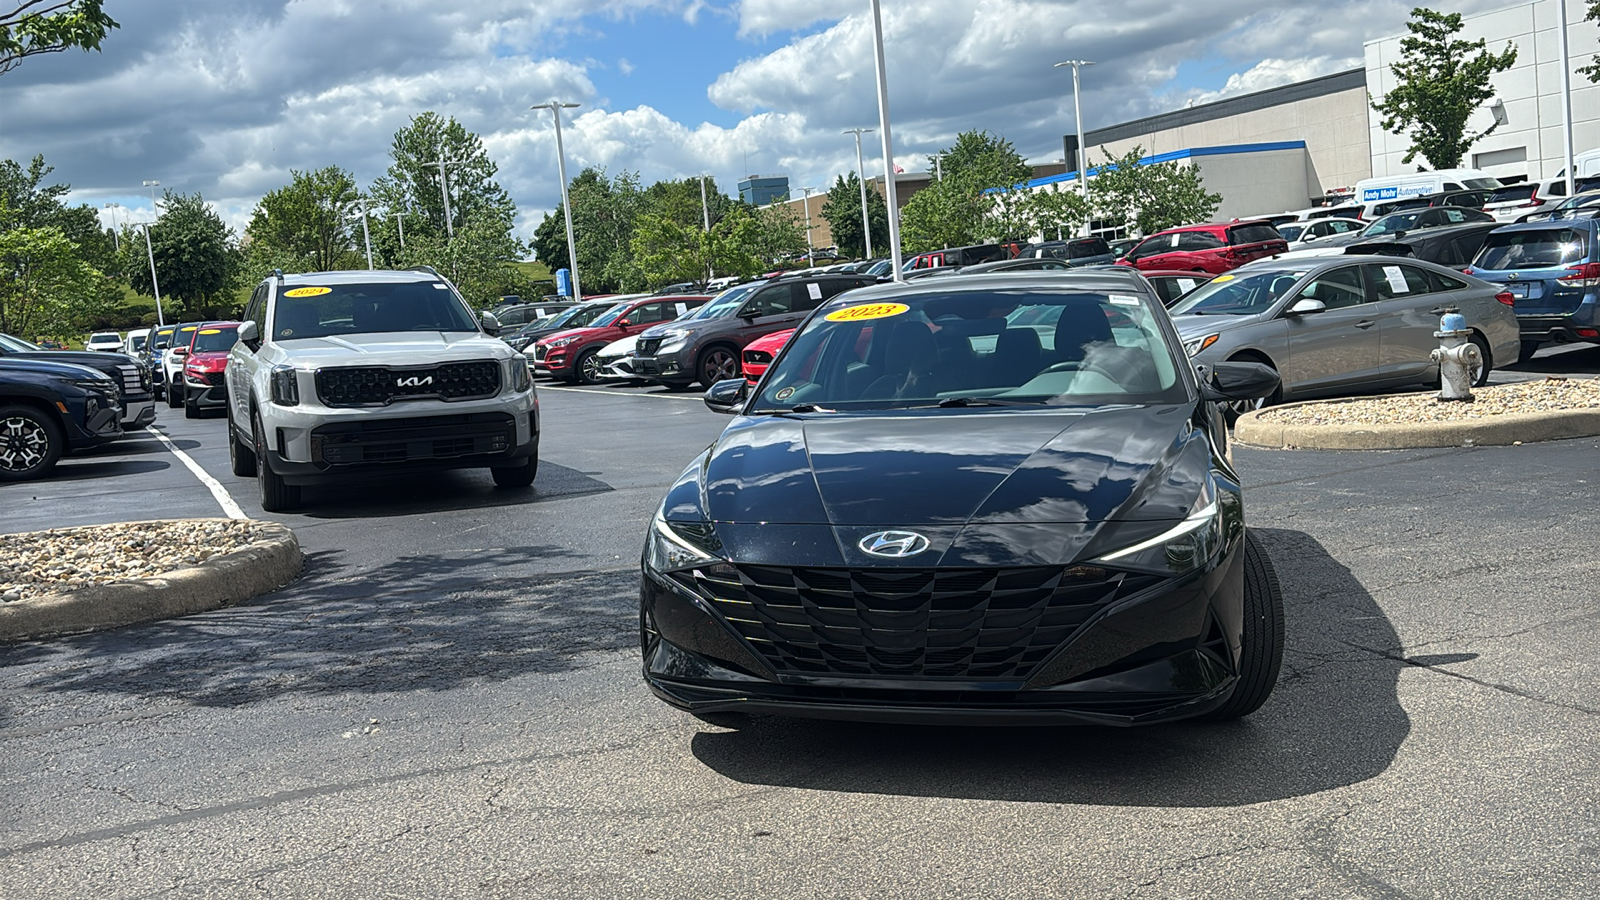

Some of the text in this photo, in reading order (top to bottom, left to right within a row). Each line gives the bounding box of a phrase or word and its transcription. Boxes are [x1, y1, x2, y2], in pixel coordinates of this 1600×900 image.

[1364, 186, 1433, 200] Andy Mohr Automotive
[293, 288, 324, 296] 2024
[836, 305, 897, 320] 2023
